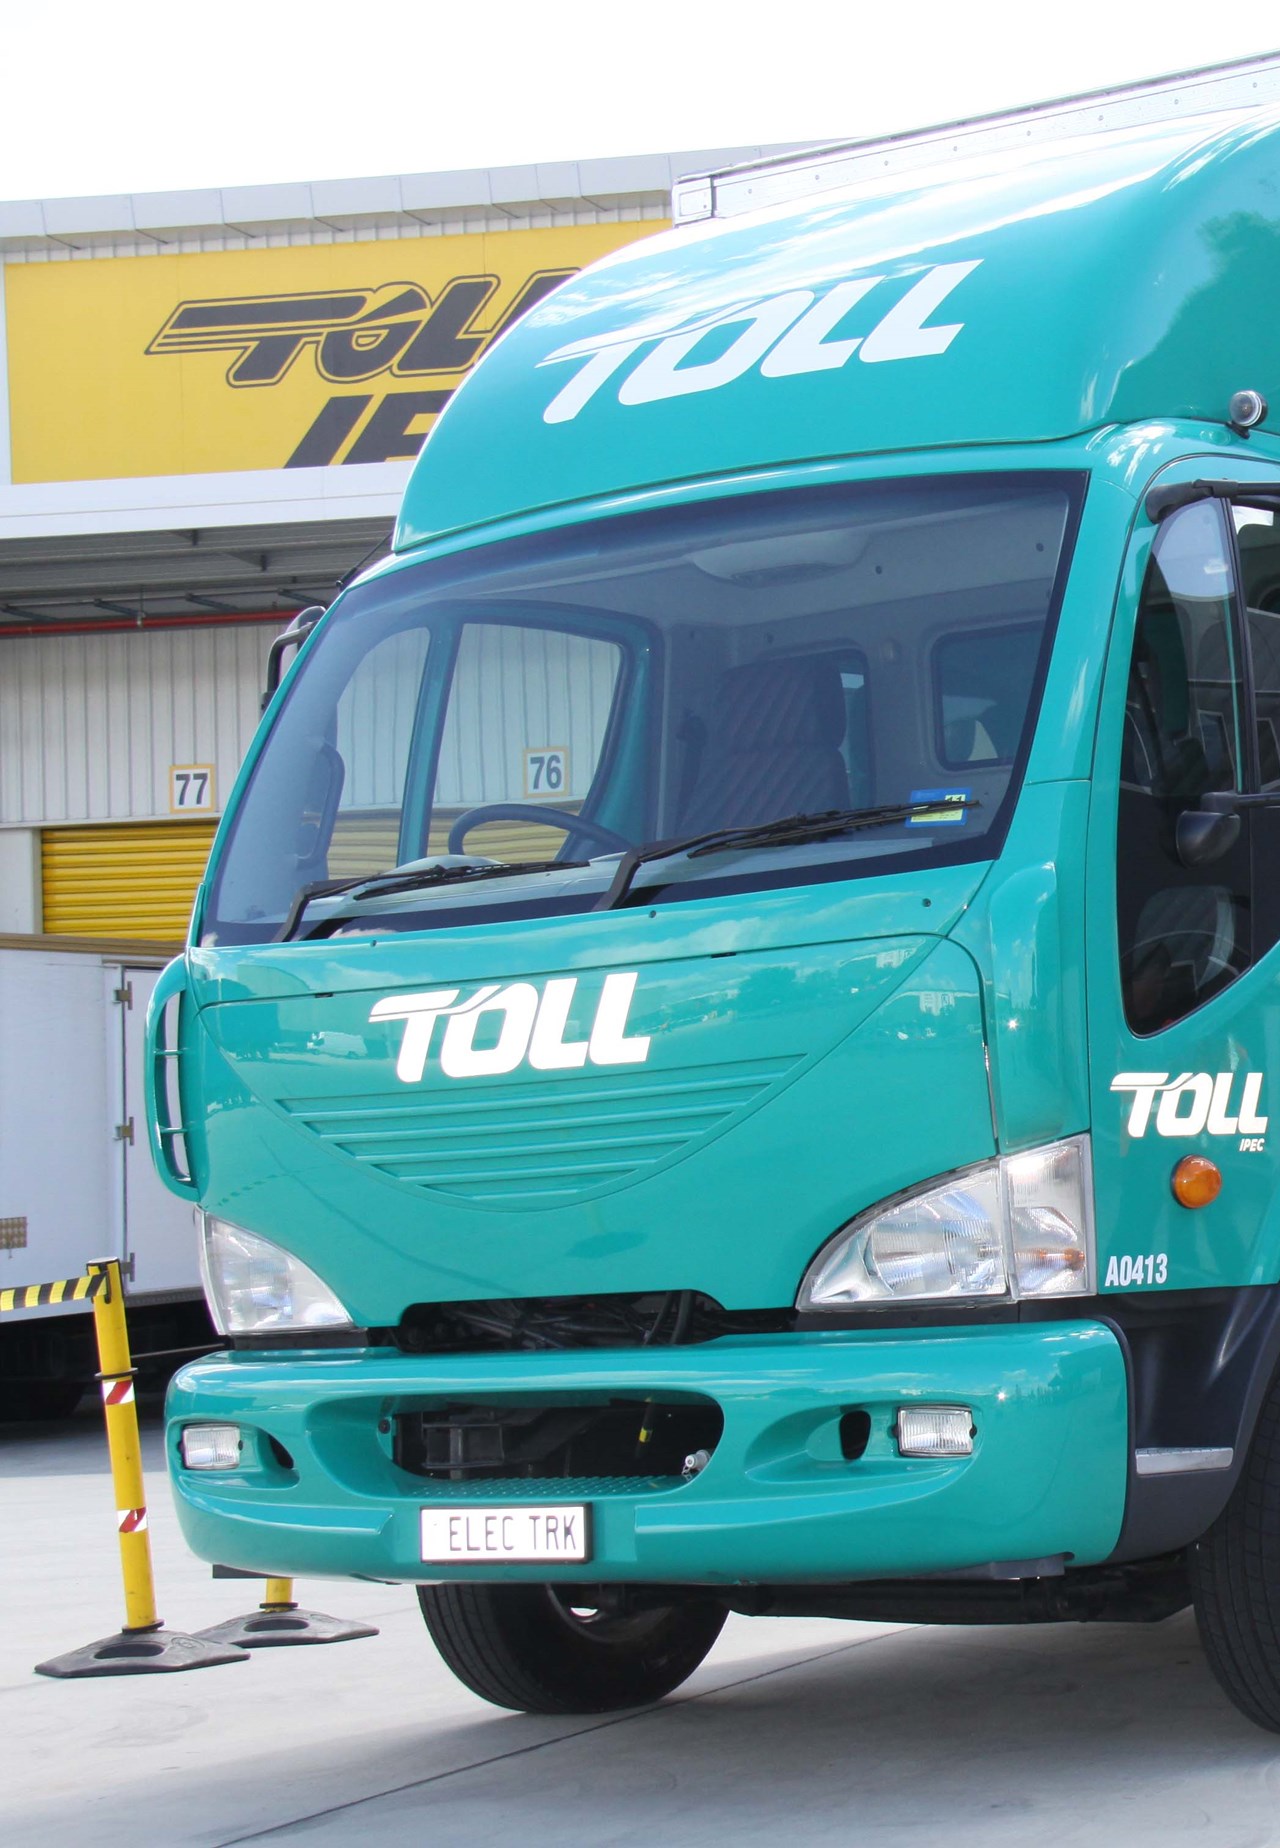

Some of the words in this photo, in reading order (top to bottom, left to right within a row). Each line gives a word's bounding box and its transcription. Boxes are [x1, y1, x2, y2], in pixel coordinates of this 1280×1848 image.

[534, 258, 986, 424] TOLL
[175, 773, 209, 806] 77
[529, 754, 563, 790] 76
[368, 971, 651, 1083] TOLL
[1109, 1072, 1269, 1138] TOLL
[1239, 1138, 1266, 1152] IPEC
[1104, 1253, 1168, 1287] A0413
[449, 1516, 514, 1551] ELEC
[528, 1515, 576, 1551] TRK
